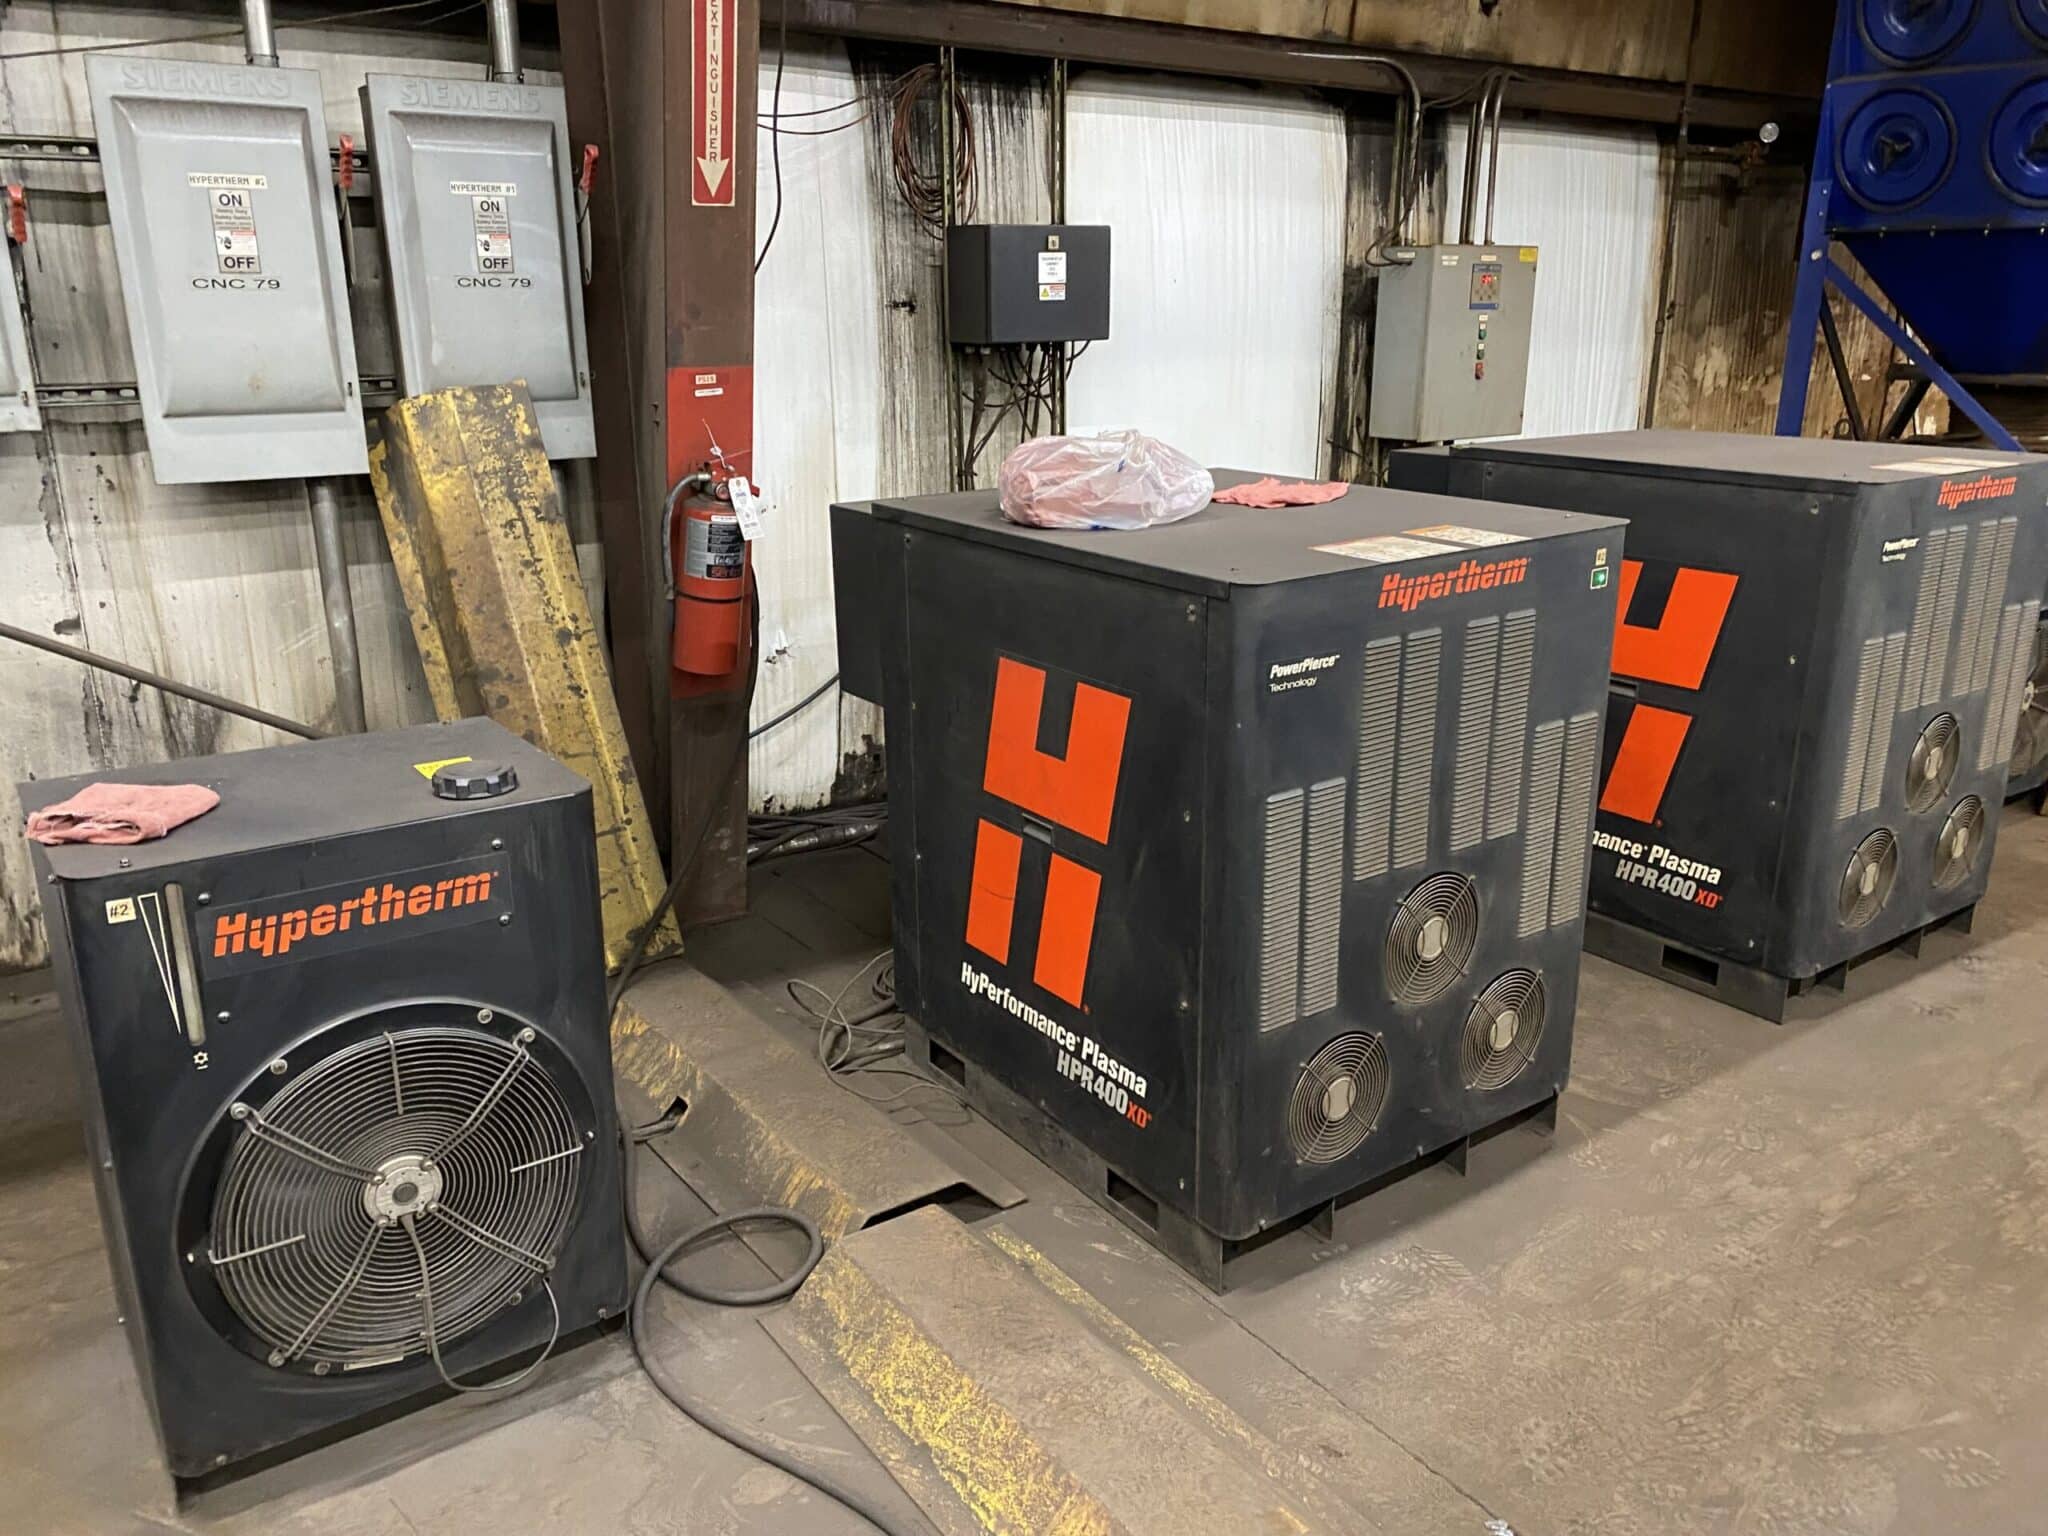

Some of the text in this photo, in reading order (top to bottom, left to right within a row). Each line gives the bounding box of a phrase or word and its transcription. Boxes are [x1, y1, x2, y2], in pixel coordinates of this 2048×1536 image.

[121, 63, 291, 99] SIEMENS
[400, 80, 541, 113] SIEMENS
[189, 175, 250, 186] HYPERTHERM
[450, 183, 502, 193] HYPERTHERM
[218, 193, 243, 207] ON
[480, 200, 500, 212] ON
[223, 256, 255, 269] OFF
[482, 257, 509, 269] OFF
[192, 278, 281, 289] CNC 79
[457, 277, 531, 288] CNC 79
[1937, 474, 2017, 510] Hypertherm
[1378, 557, 1528, 612] Hypertherm
[1269, 676, 1317, 693] Technology
[1647, 844, 1721, 885] Plasma
[110, 903, 129, 918] #2
[214, 871, 493, 957] Hypertherm
[961, 961, 1147, 1099] HyPerformance Plasma
